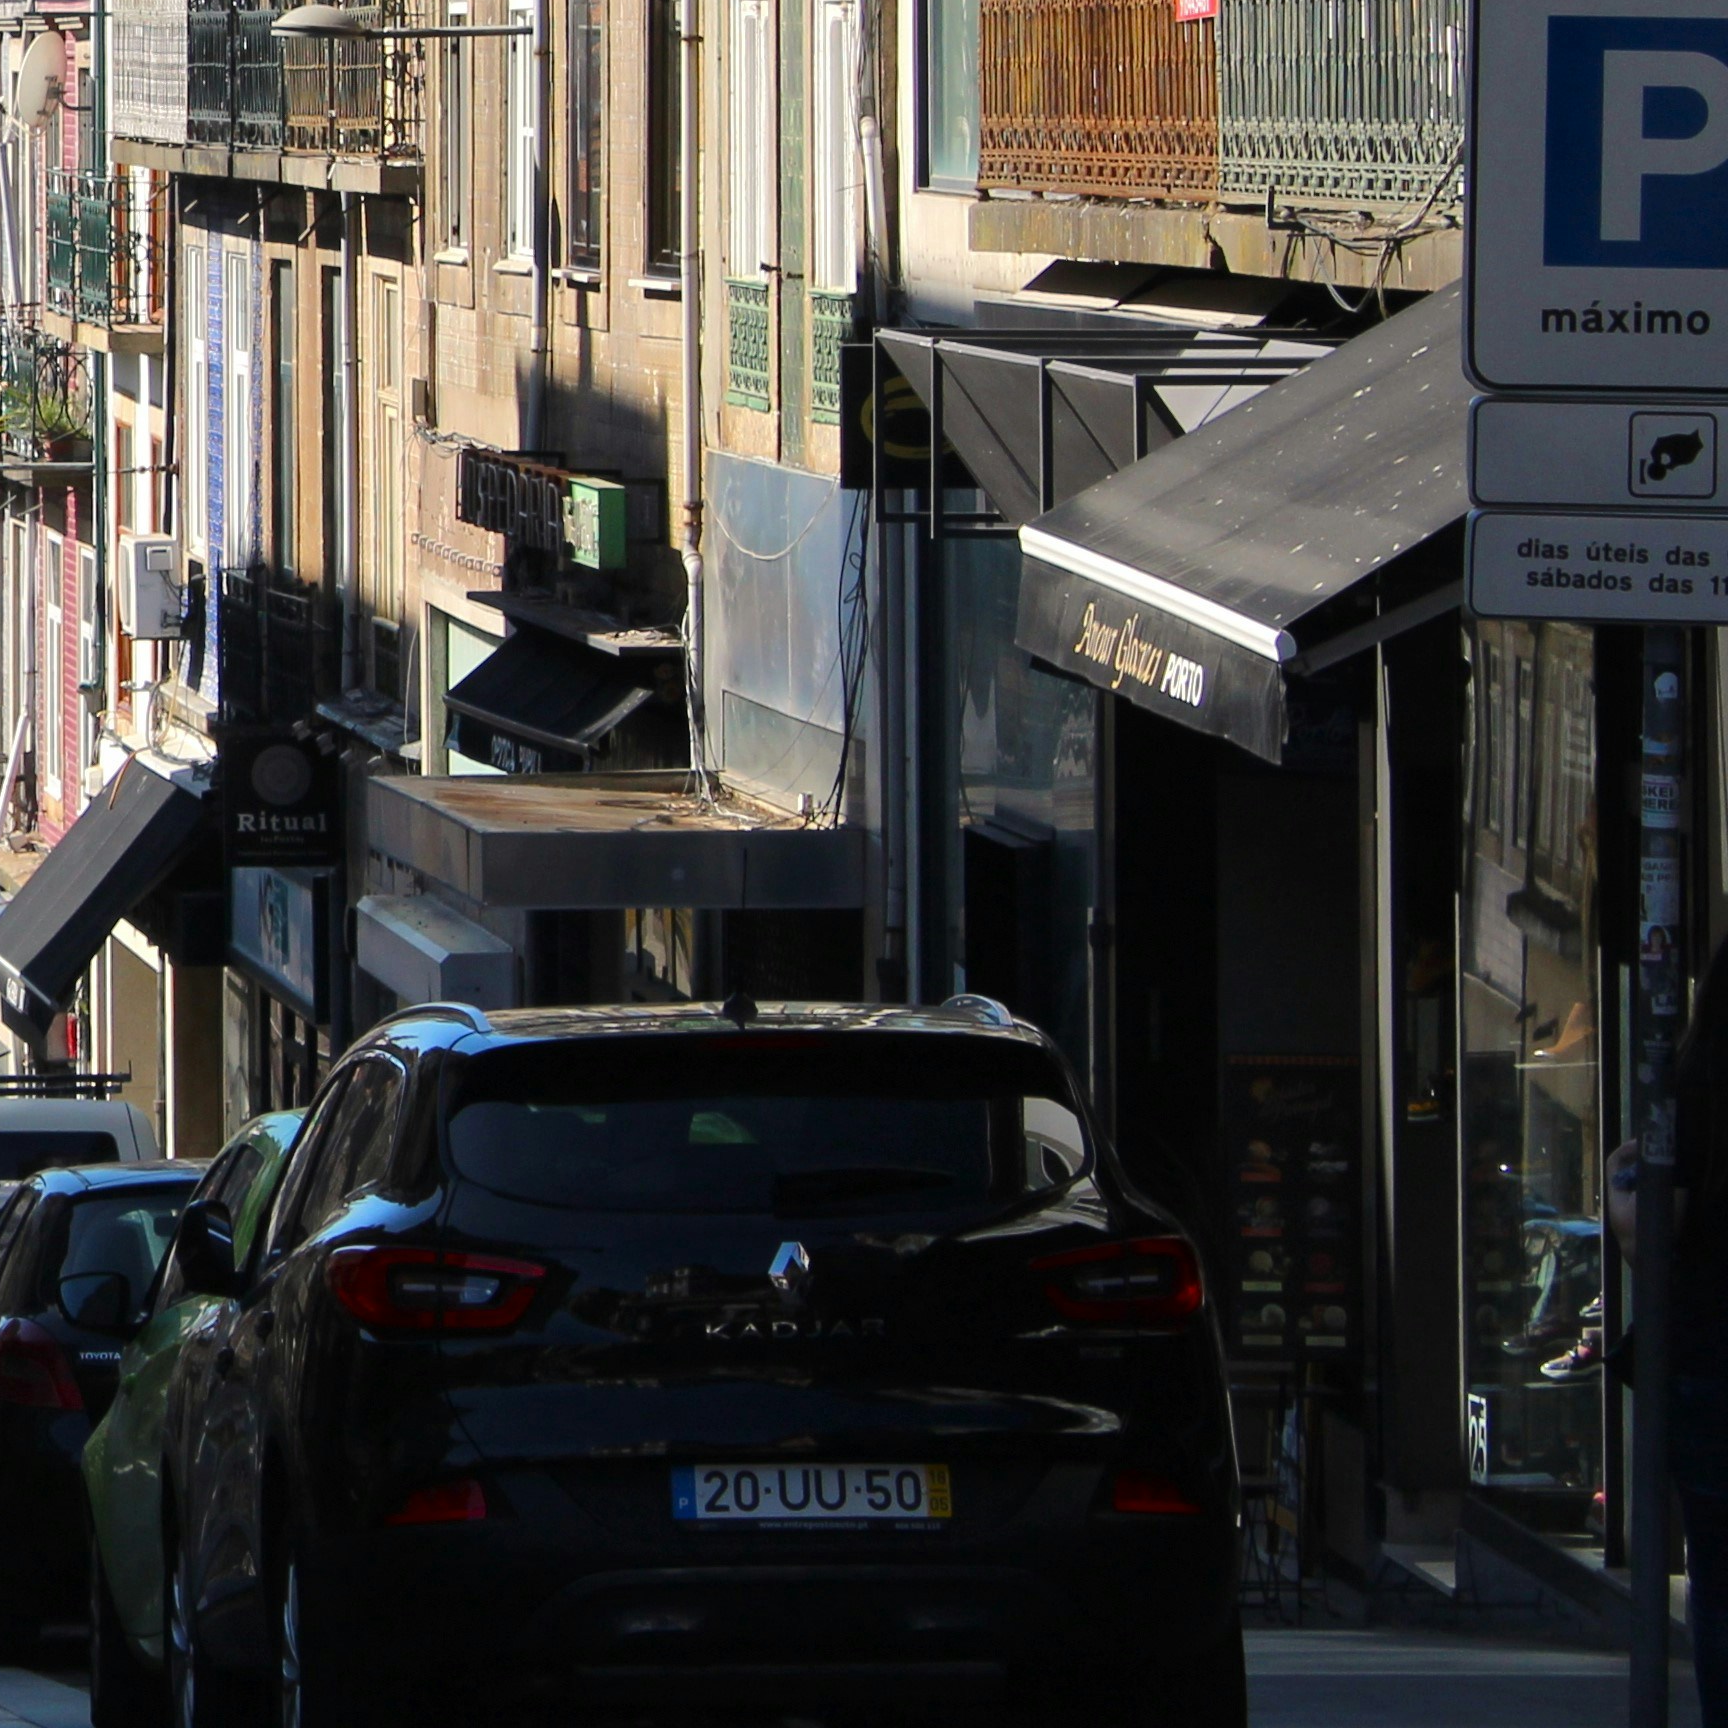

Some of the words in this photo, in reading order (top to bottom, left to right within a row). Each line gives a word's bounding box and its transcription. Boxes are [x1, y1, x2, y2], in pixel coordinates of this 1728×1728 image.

[1600, 50, 1728, 241] P
[1541, 300, 1710, 335] máximo
[1517, 538, 1569, 560] dias
[1586, 541, 1649, 564] úteis
[1665, 546, 1710, 568] das
[1526, 569, 1632, 592] sábados
[1649, 573, 1694, 594] das
[1160, 652, 1204, 707] PORTO
[236, 809, 328, 833] Ritual
[704, 1318, 884, 1340] KADJAR
[79, 1351, 121, 1360] TOYOTA
[678, 1497, 688, 1509] P
